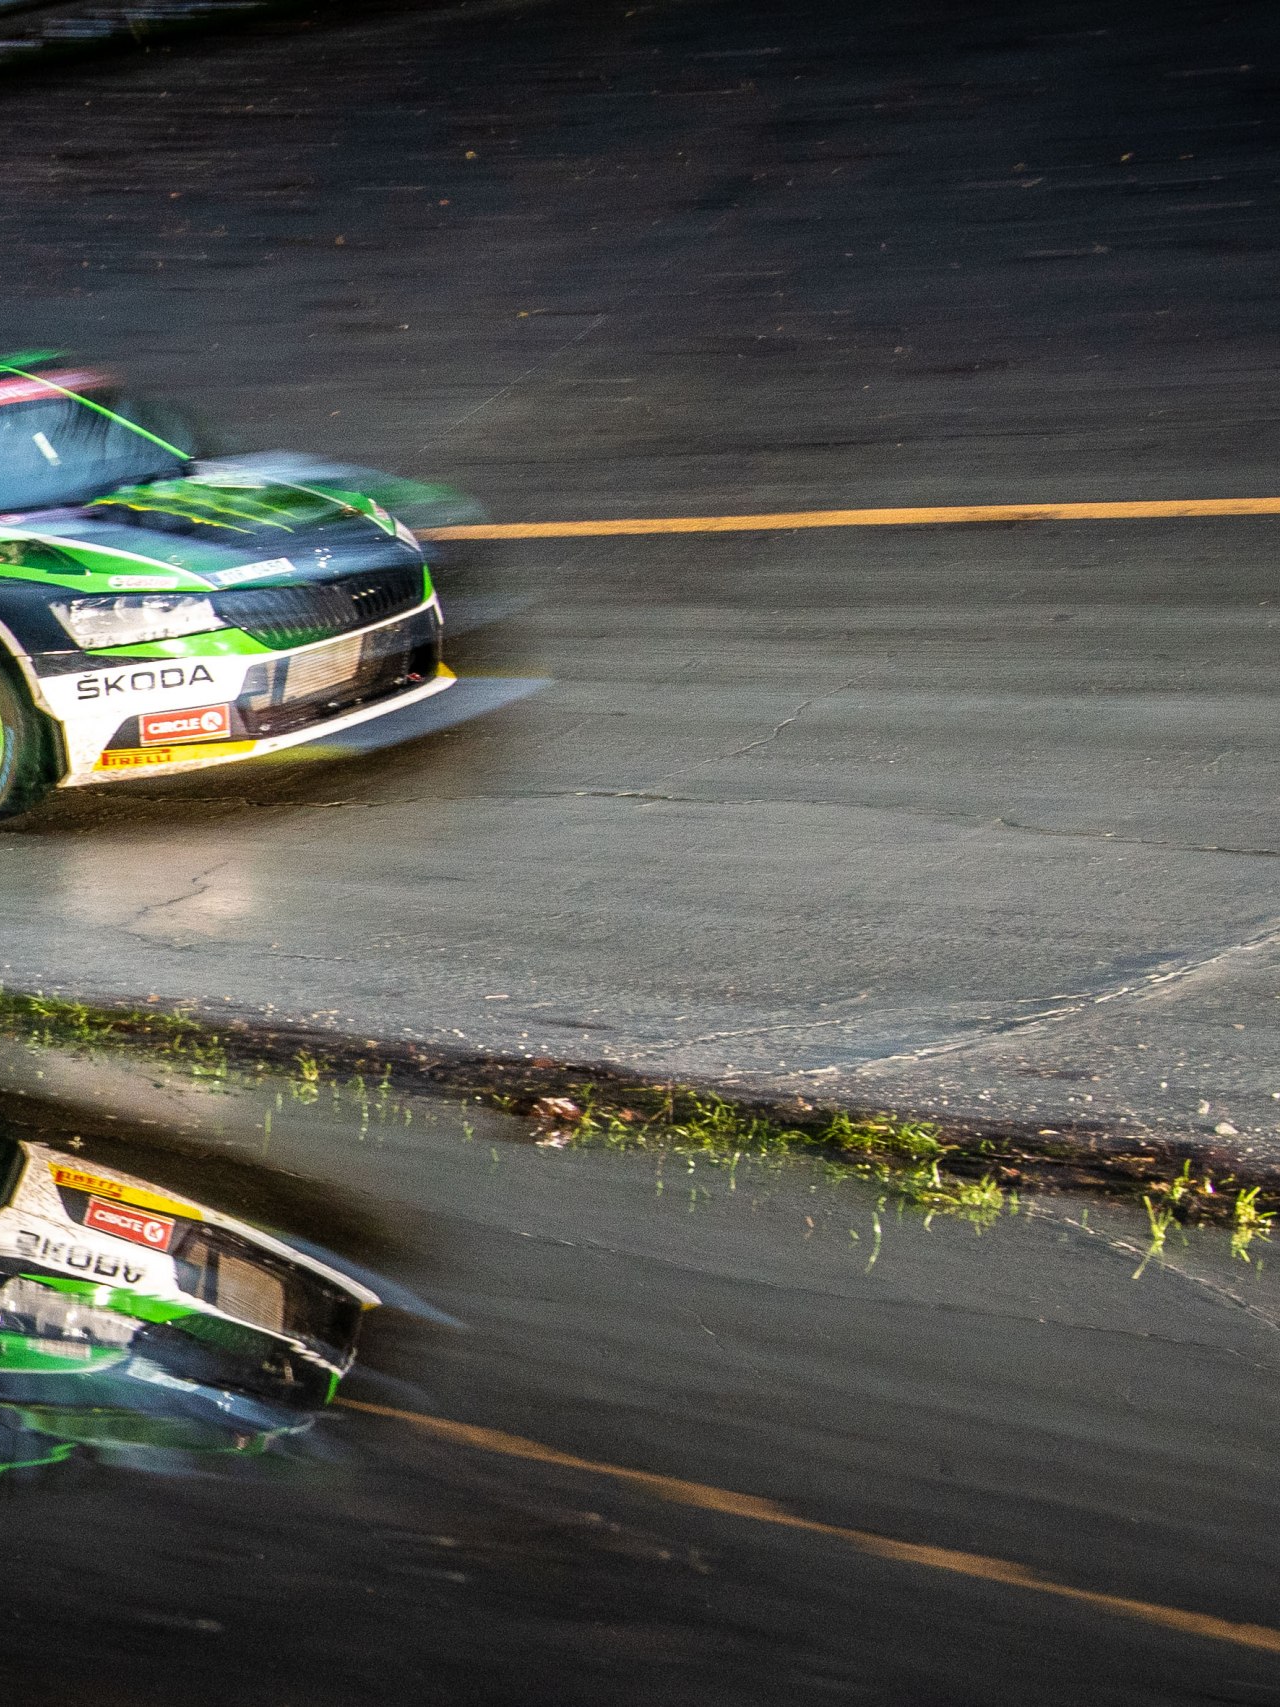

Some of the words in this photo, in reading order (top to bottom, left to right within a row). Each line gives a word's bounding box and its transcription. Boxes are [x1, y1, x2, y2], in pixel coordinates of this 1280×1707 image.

[76, 664, 215, 701] ŠKODA
[147, 718, 200, 735] CIRCLE
[101, 748, 171, 767] PIRELLI
